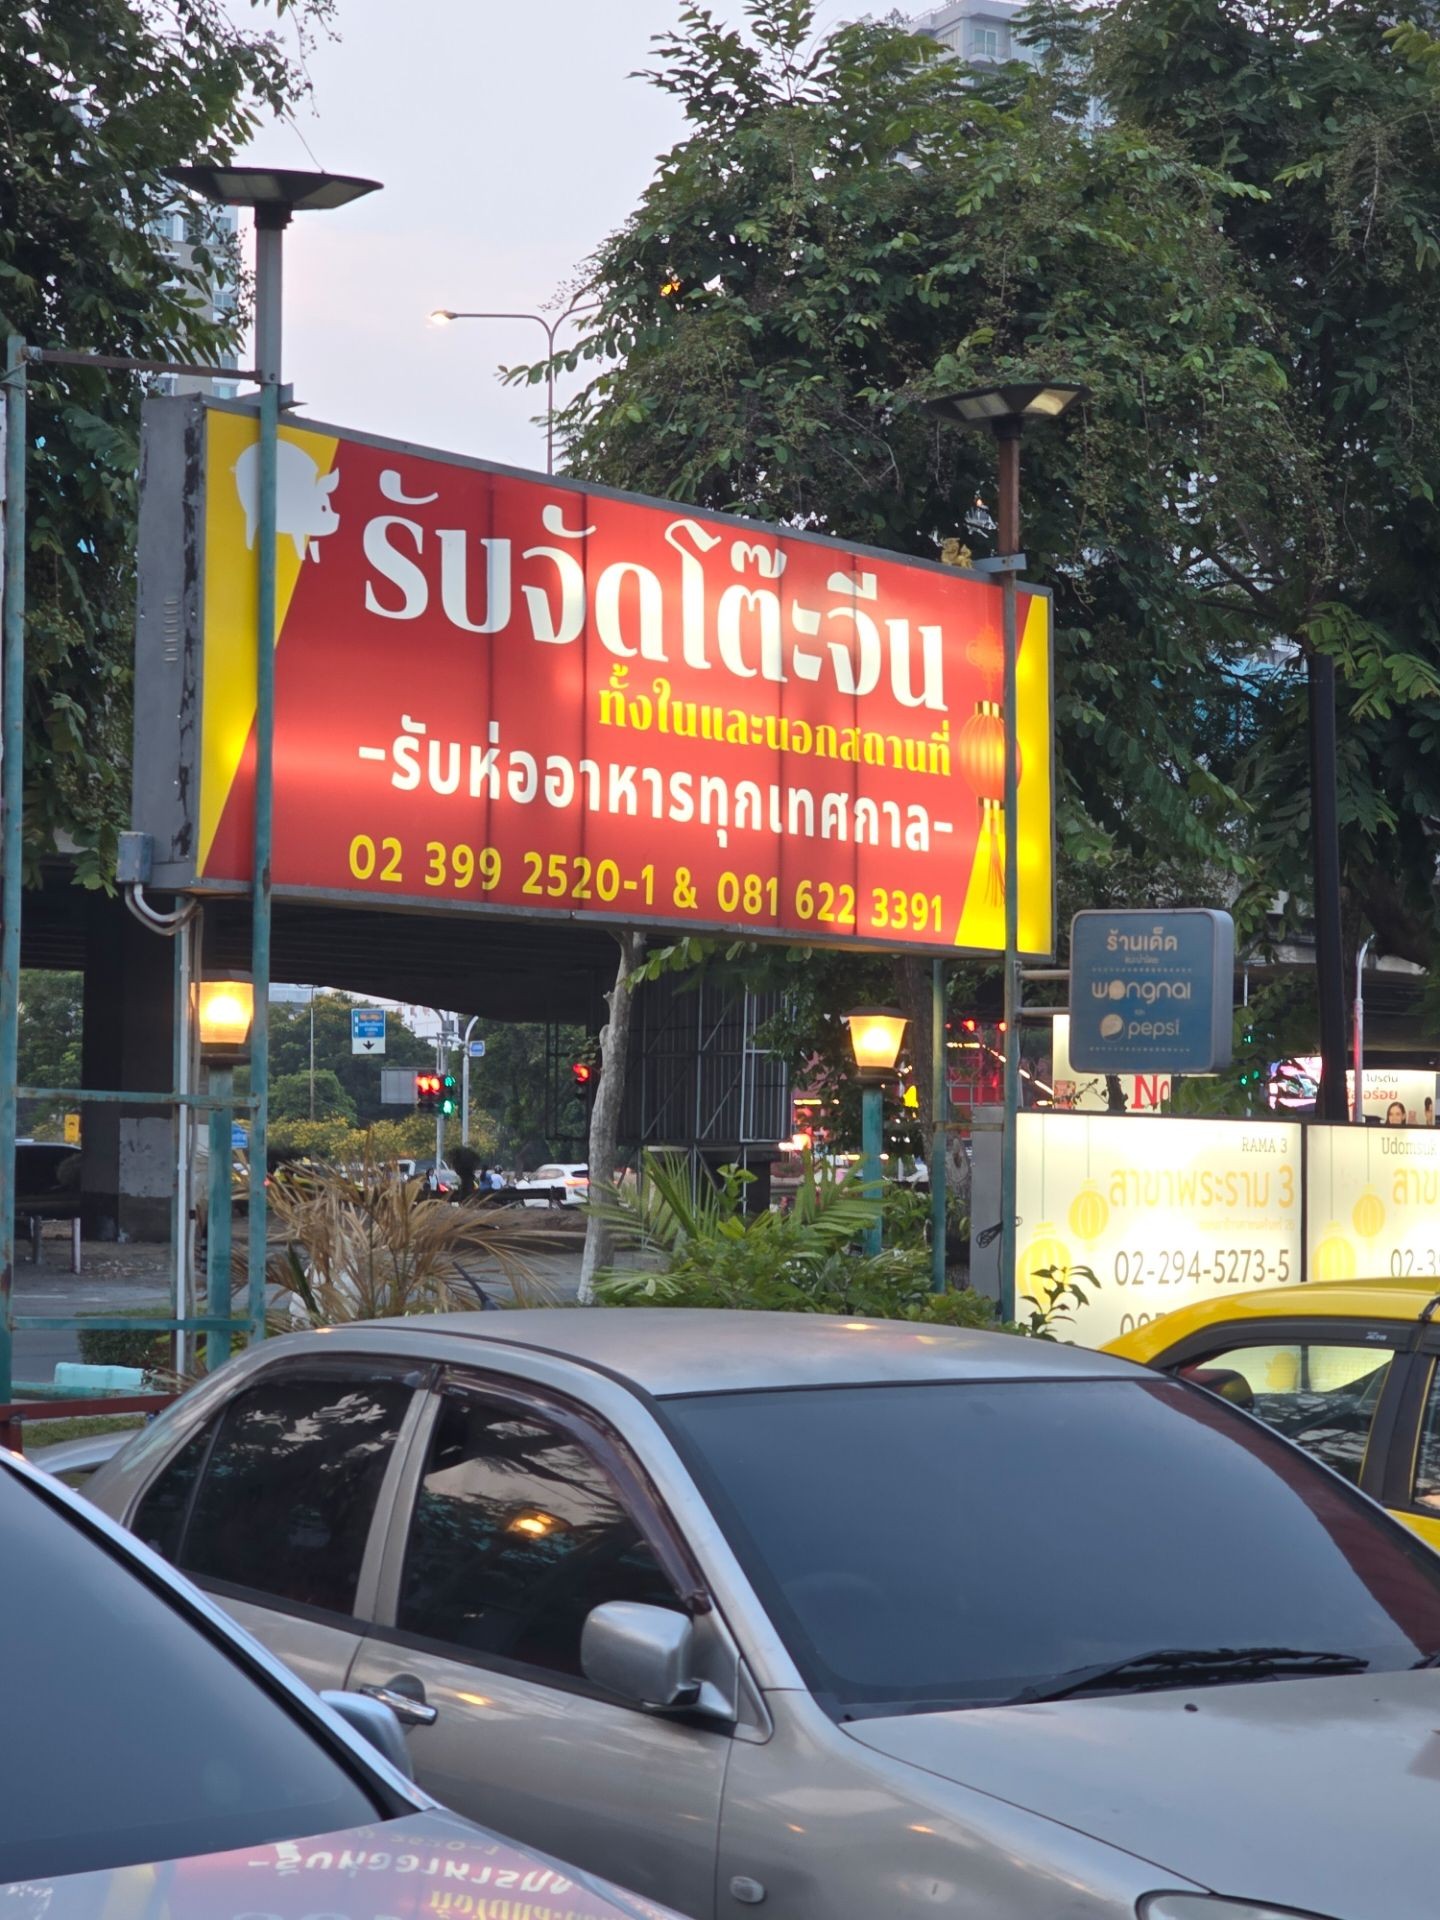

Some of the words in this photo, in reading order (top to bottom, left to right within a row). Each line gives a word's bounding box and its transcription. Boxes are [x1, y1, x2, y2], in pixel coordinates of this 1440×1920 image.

[362, 468, 948, 712] รับจัดโต๊ะจีน
[599, 663, 952, 776] ทั้งในและนอกสถานที่
[358, 713, 954, 852] -รับห่ออาหารทุกเทศกาล-
[348, 833, 403, 883] 02
[425, 840, 503, 892] 399
[521, 850, 656, 906] 2520-1
[672, 866, 698, 910] &
[717, 871, 779, 918] 081
[795, 879, 856, 925] 622
[870, 886, 943, 933] 3391
[1106, 925, 1178, 951] ร้านเด็ด
[1127, 1017, 1180, 1040] pepsi
[1241, 1136, 1276, 1153] RAMA
[1280, 1137, 1288, 1154] 3
[1109, 1168, 1271, 1208] สาขาพระราม
[1278, 1163, 1295, 1209] 3
[1114, 1248, 1290, 1287] 02-294-5273-5
